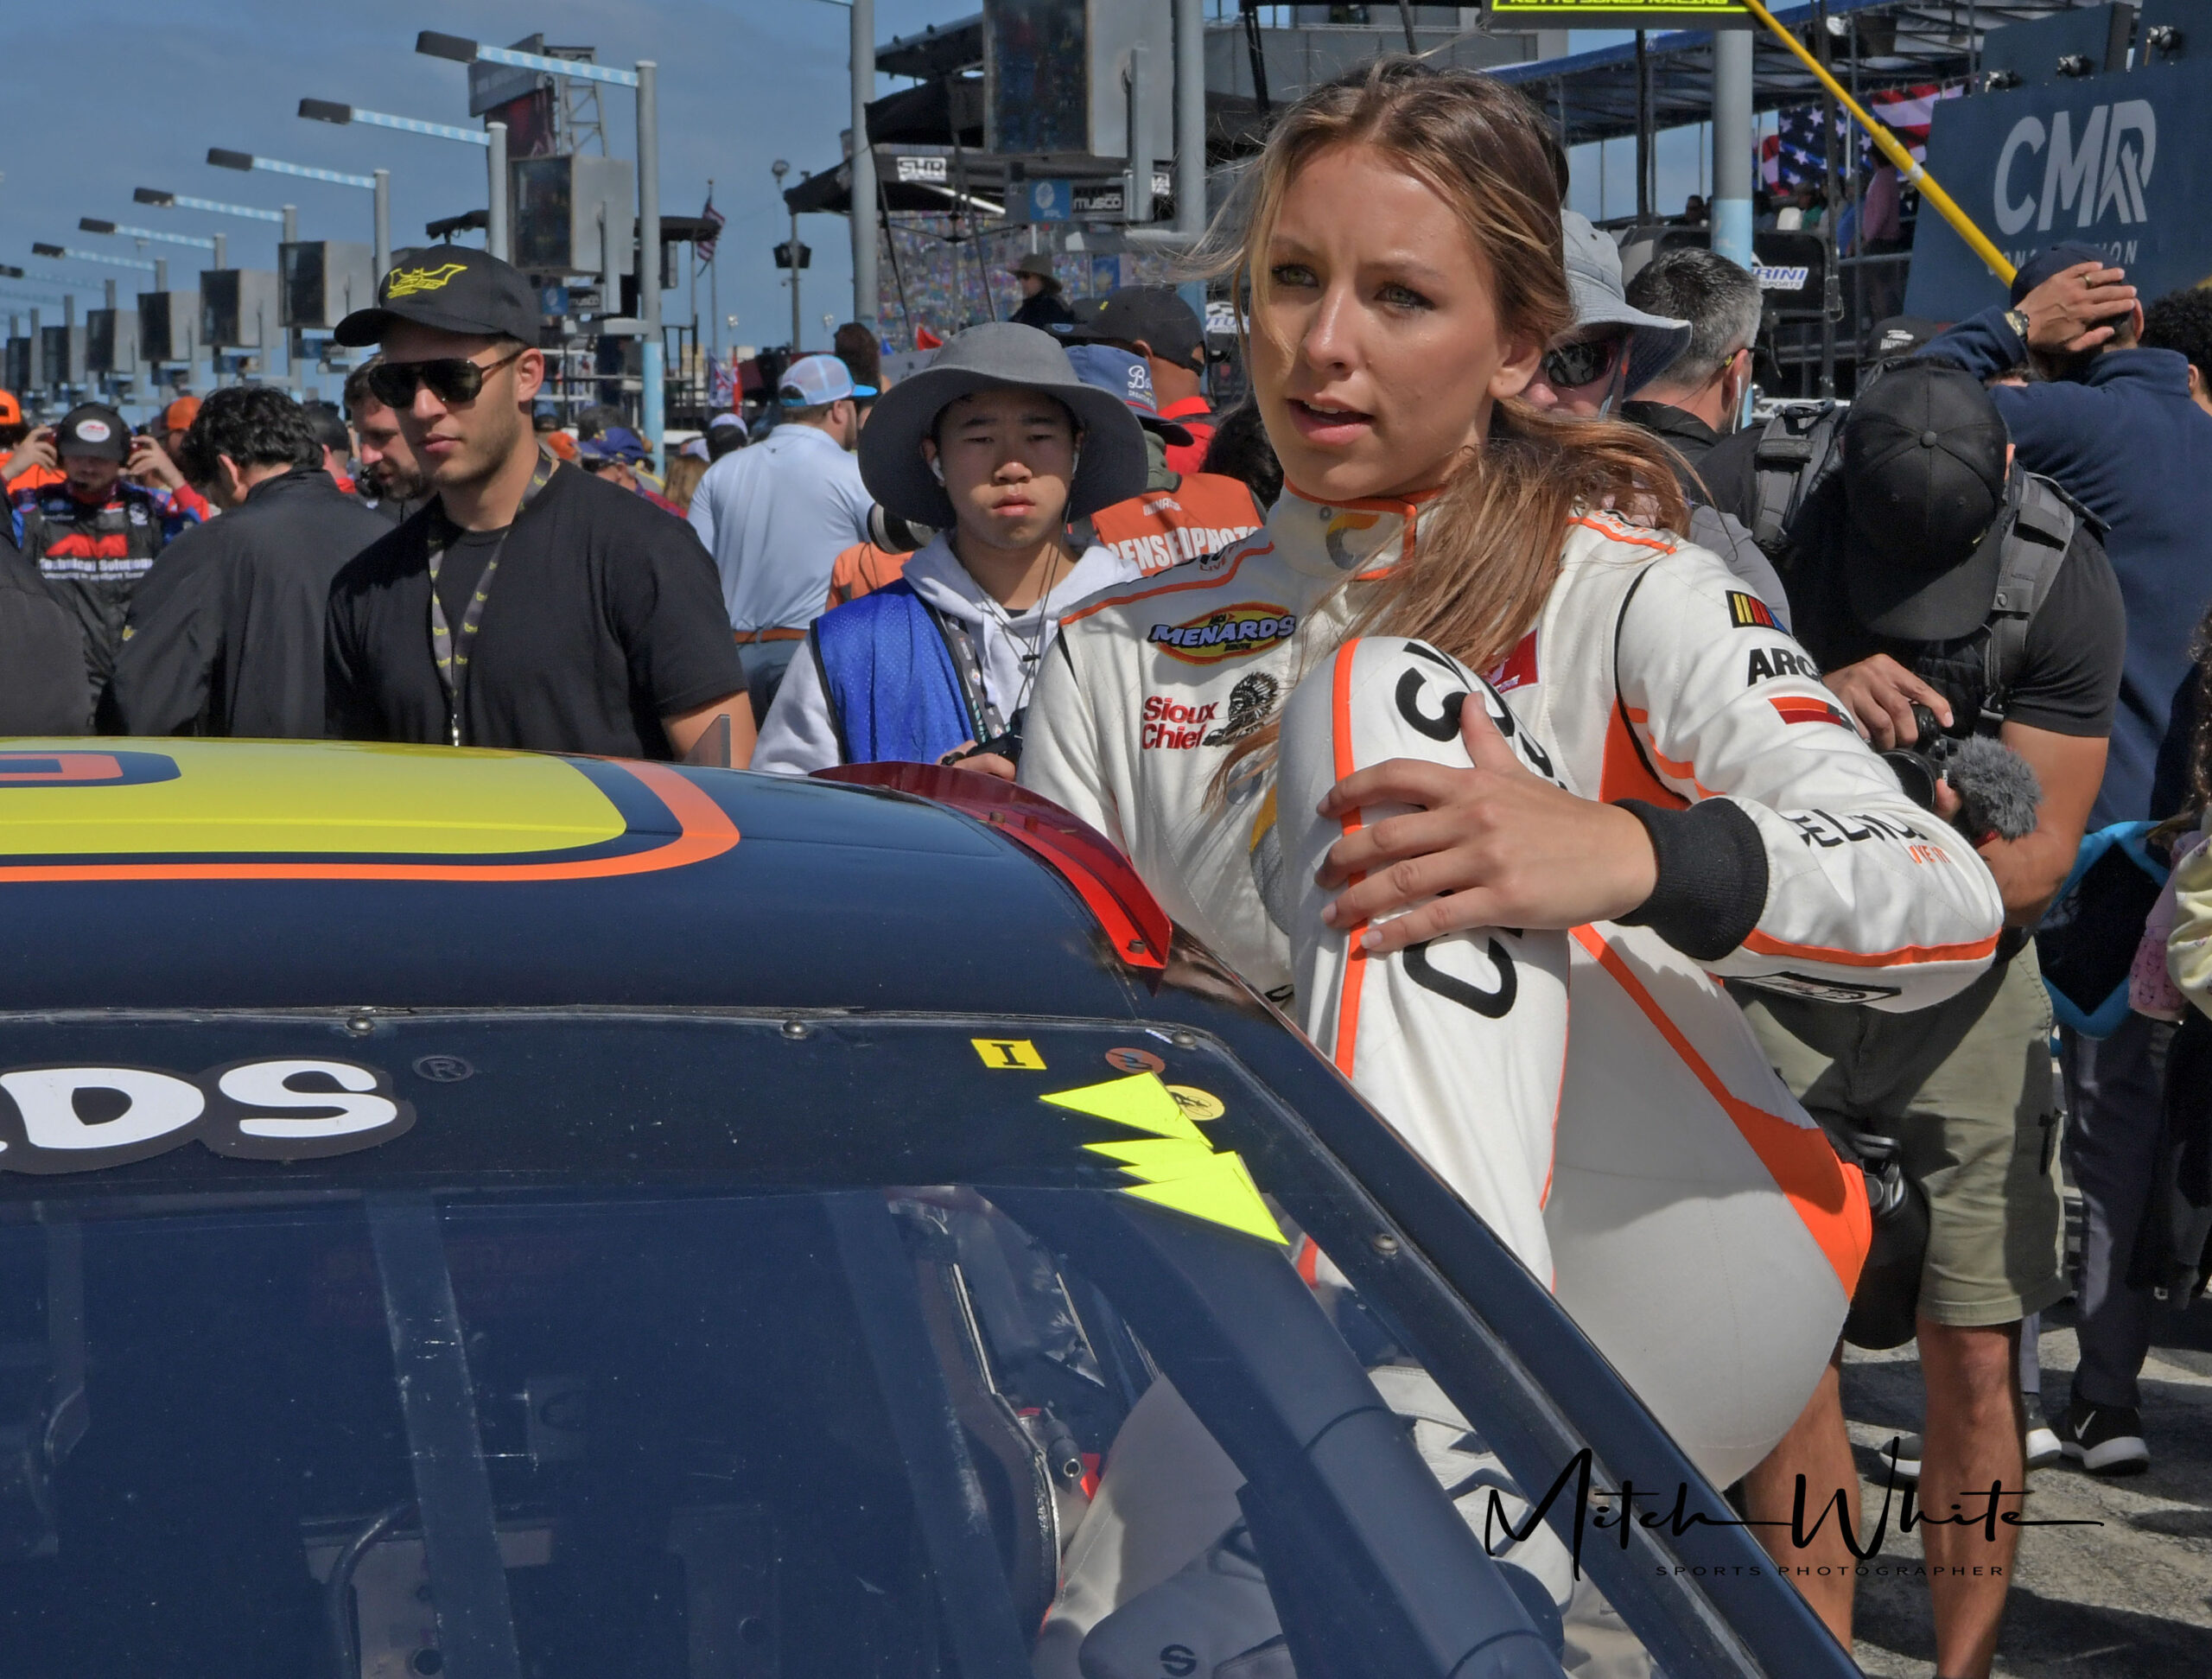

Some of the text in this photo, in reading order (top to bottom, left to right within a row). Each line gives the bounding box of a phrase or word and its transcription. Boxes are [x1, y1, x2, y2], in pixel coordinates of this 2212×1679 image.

[1752, 267, 1806, 281] RINI
[1149, 614, 1296, 648] MENARDS
[1747, 647, 1822, 688] ARC
[1141, 695, 1219, 723] Sioux
[1141, 723, 1207, 750] Chief
[0, 1059, 397, 1151] DS
